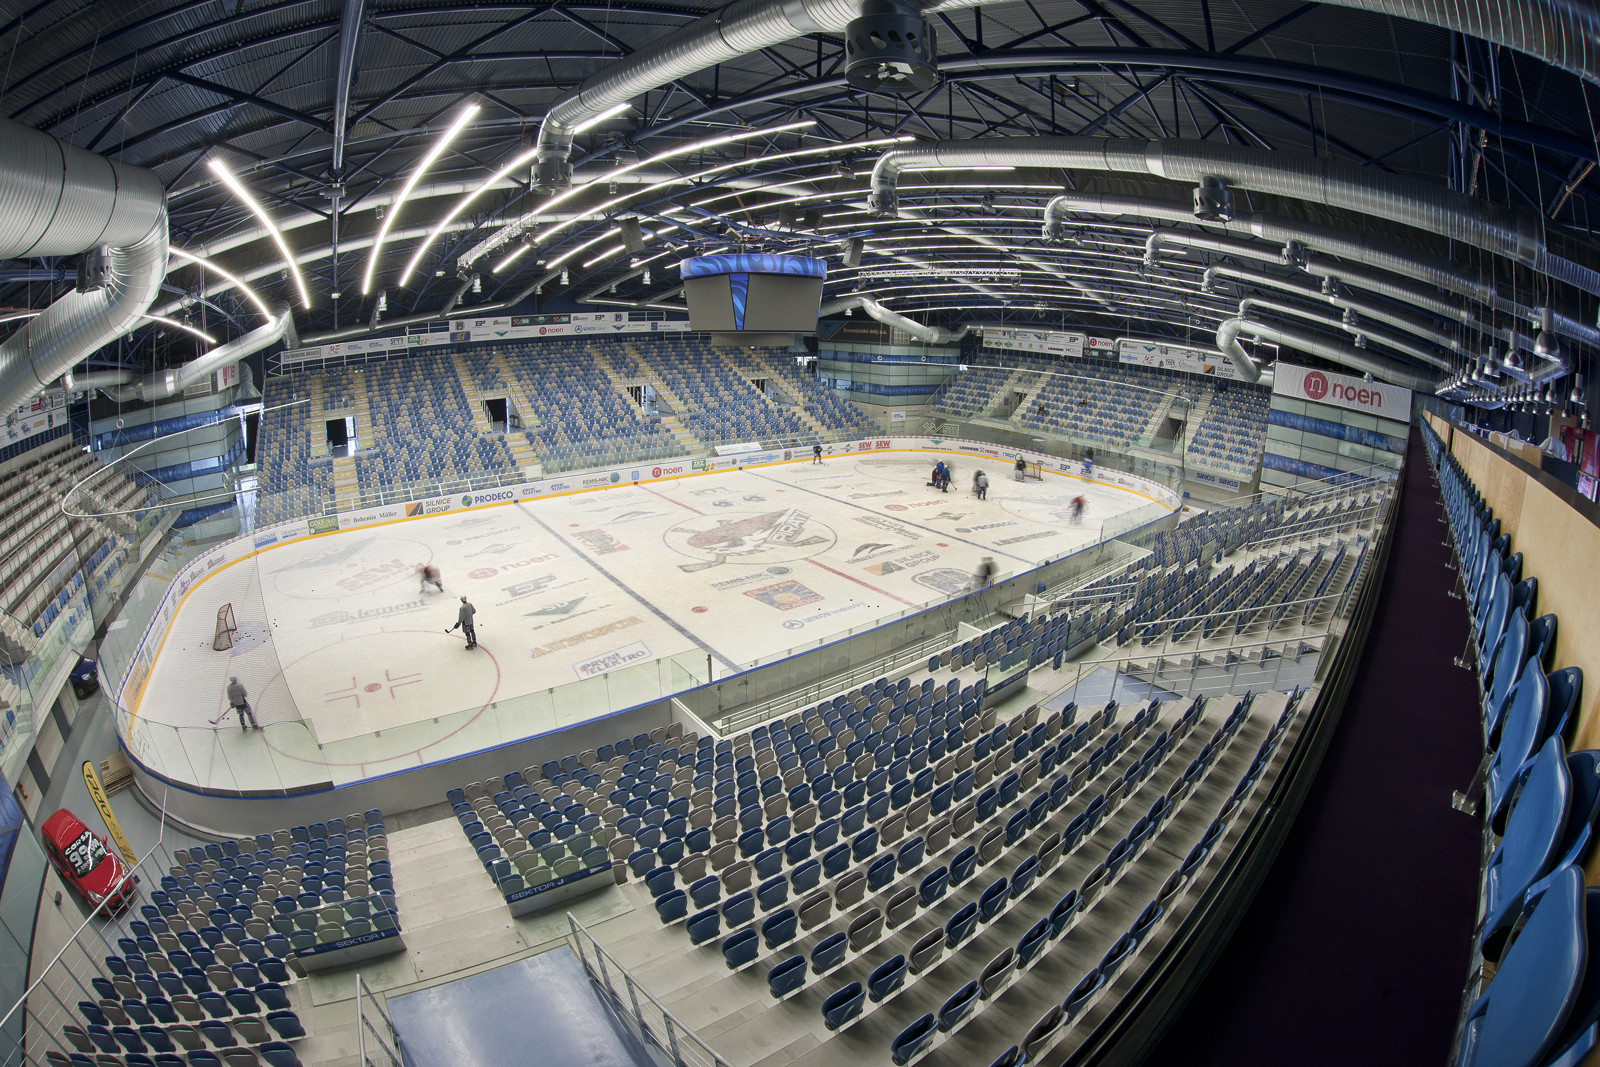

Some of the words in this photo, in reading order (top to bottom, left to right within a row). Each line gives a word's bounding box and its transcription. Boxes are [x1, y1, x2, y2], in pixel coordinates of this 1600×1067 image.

[1332, 382, 1382, 408] noen
[663, 466, 682, 475] noen
[1196, 472, 1215, 482] SINGS
[1218, 478, 1238, 487] SINGS
[426, 498, 451, 507] SILNICE
[474, 491, 514, 504] PRODECO
[426, 506, 451, 514] GROUP
[590, 651, 646, 674] ELEKTRO
[65, 831, 91, 856] CORSA
[511, 882, 554, 900] SEKTOR
[336, 934, 378, 948] SEKTOR
